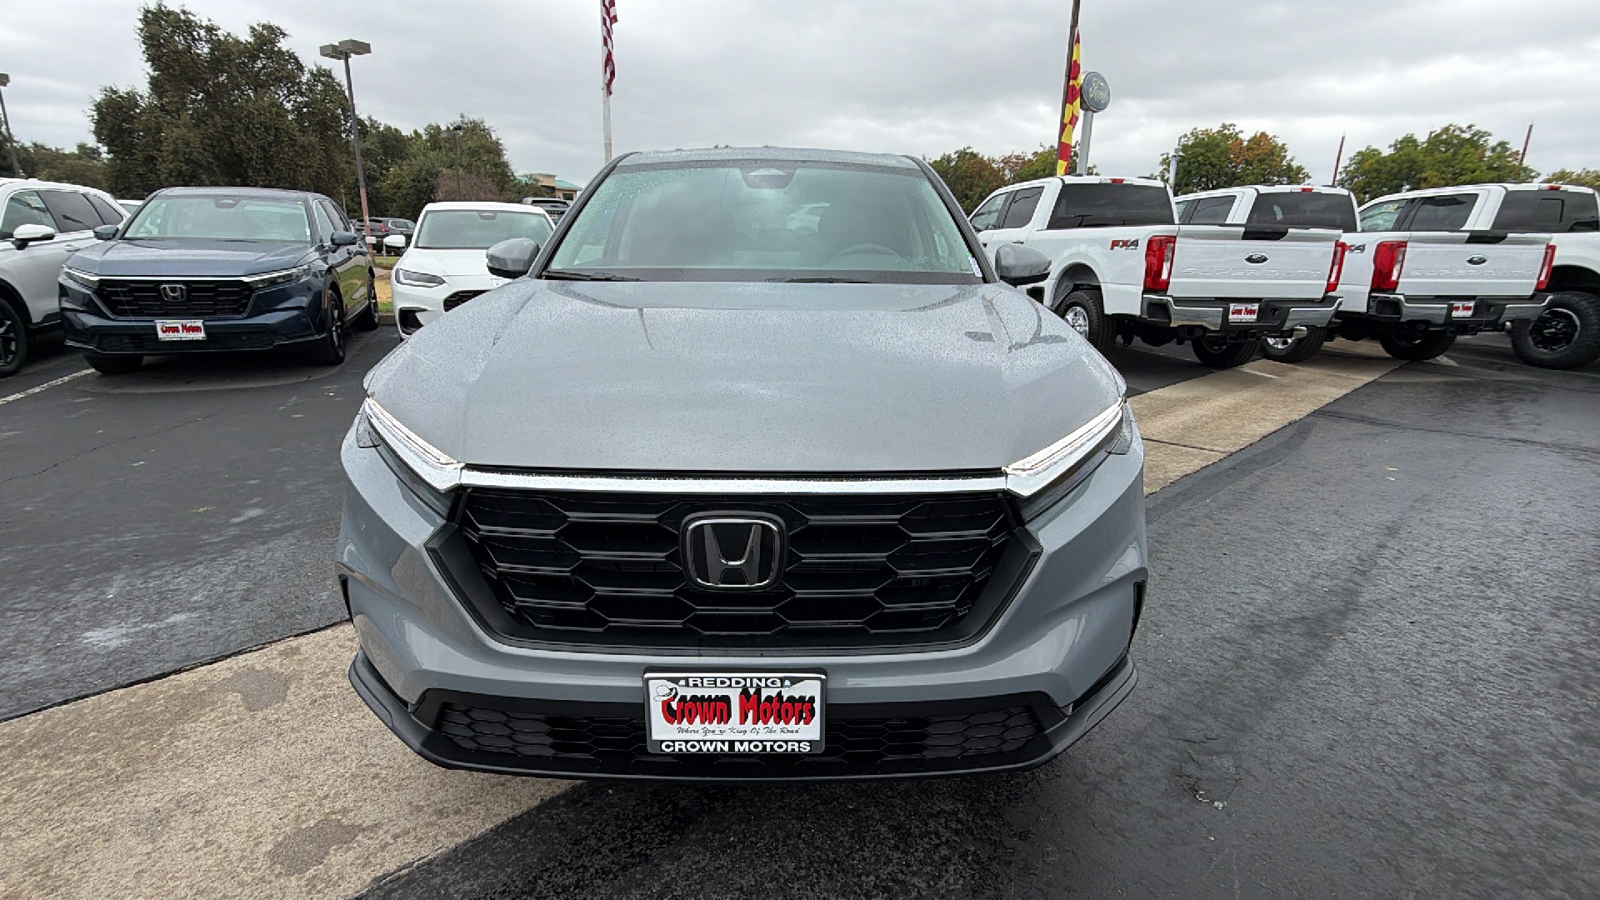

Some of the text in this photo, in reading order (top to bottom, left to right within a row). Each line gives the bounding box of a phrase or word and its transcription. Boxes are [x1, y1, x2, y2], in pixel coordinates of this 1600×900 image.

[1110, 239, 1139, 250] FX4
[1182, 267, 1260, 276] SUPER
[688, 678, 781, 688] REDDING
[661, 688, 816, 726] Crown Motors
[729, 727, 747, 735] King
[750, 727, 760, 735] Of
[763, 726, 777, 734] The
[661, 741, 811, 752] CROWN MOTORS
